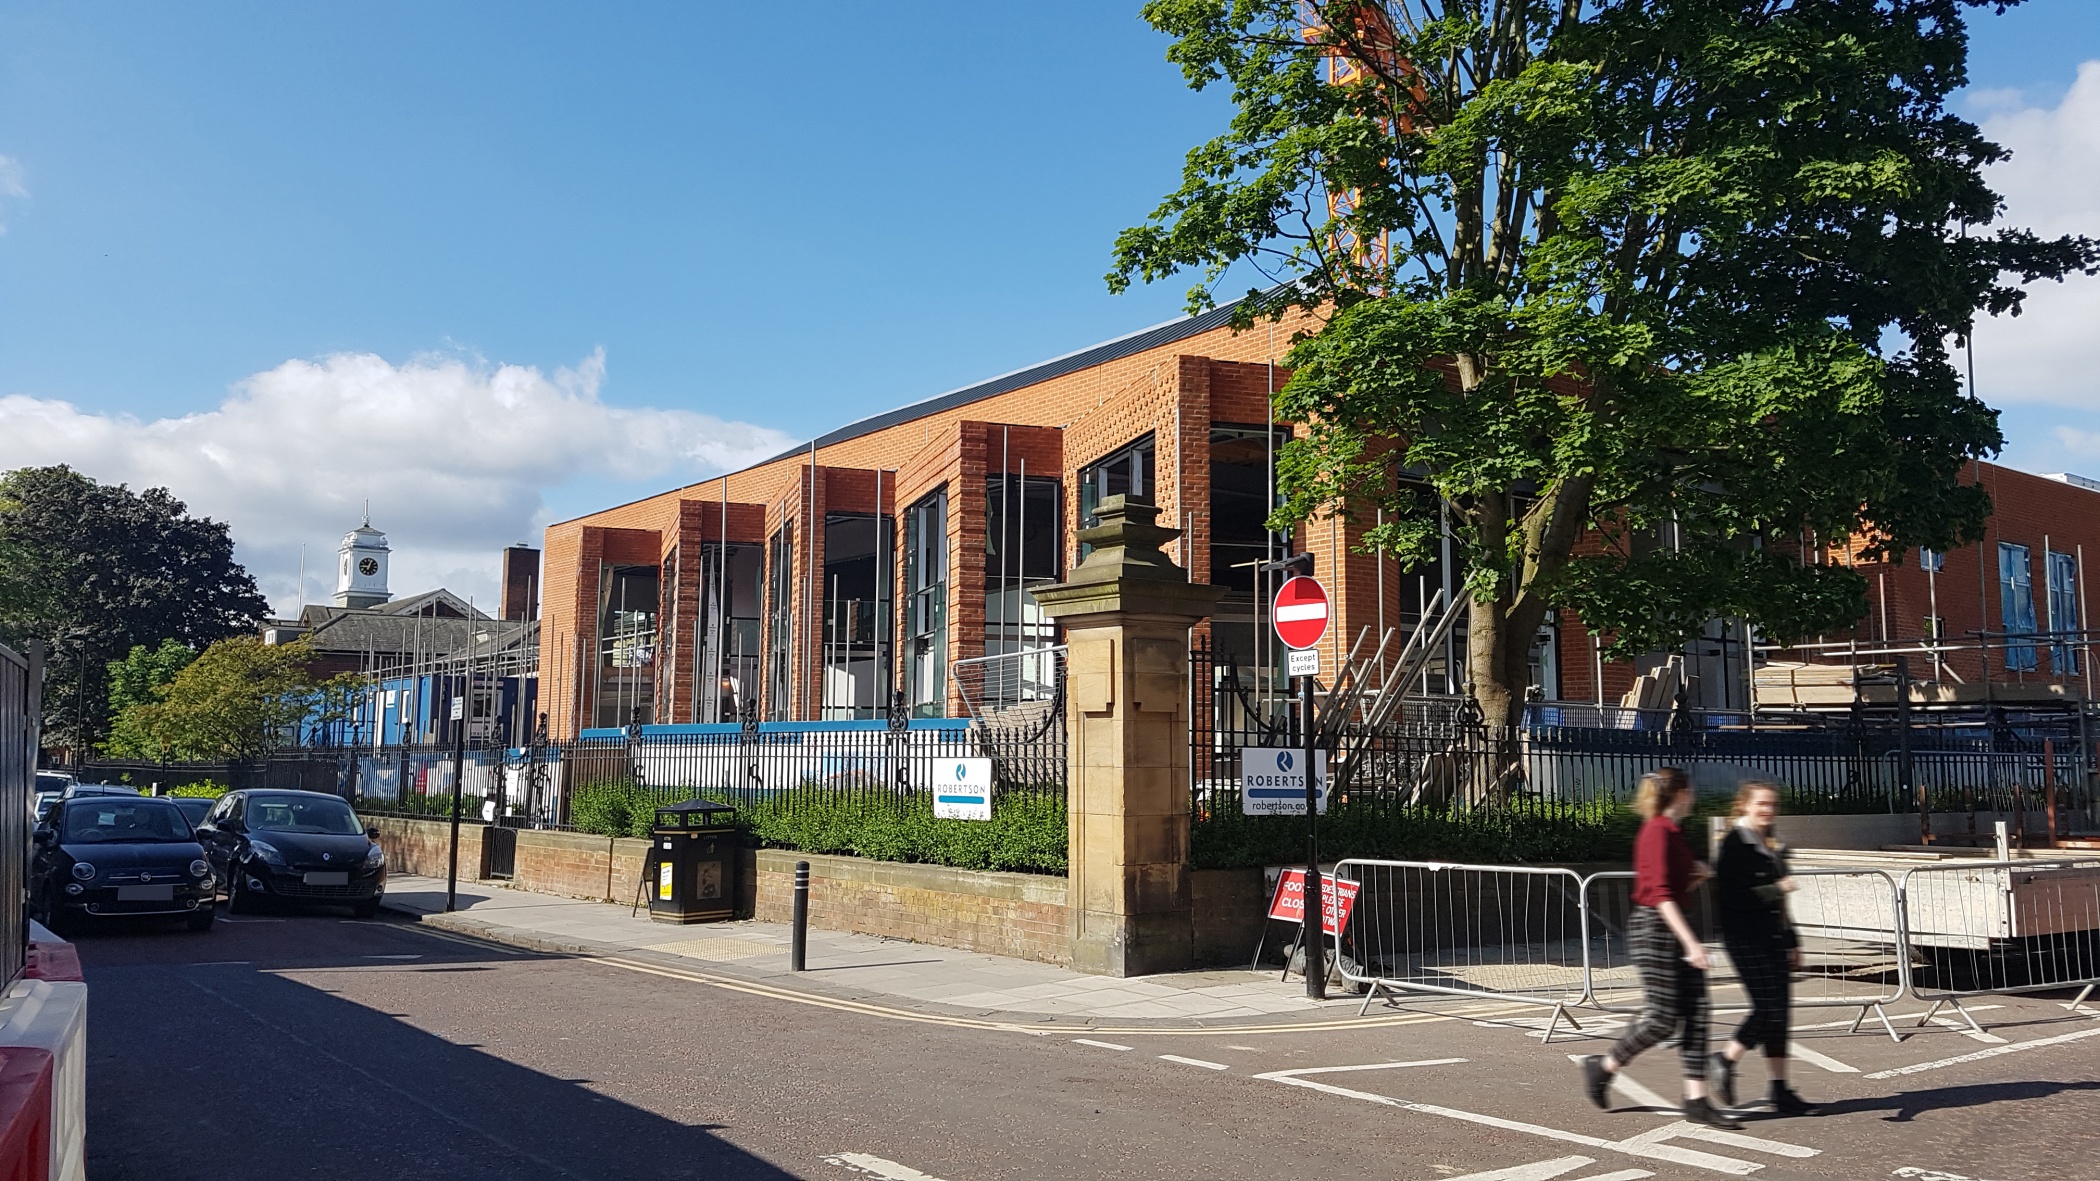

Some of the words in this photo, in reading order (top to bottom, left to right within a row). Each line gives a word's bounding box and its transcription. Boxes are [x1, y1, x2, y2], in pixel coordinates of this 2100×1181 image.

[1291, 654, 1316, 663] Except
[1292, 663, 1315, 672] cycles
[1247, 775, 1323, 787] ROBERTSN
[938, 784, 986, 794] ROBERTSON
[1281, 897, 1304, 910] CLOS
